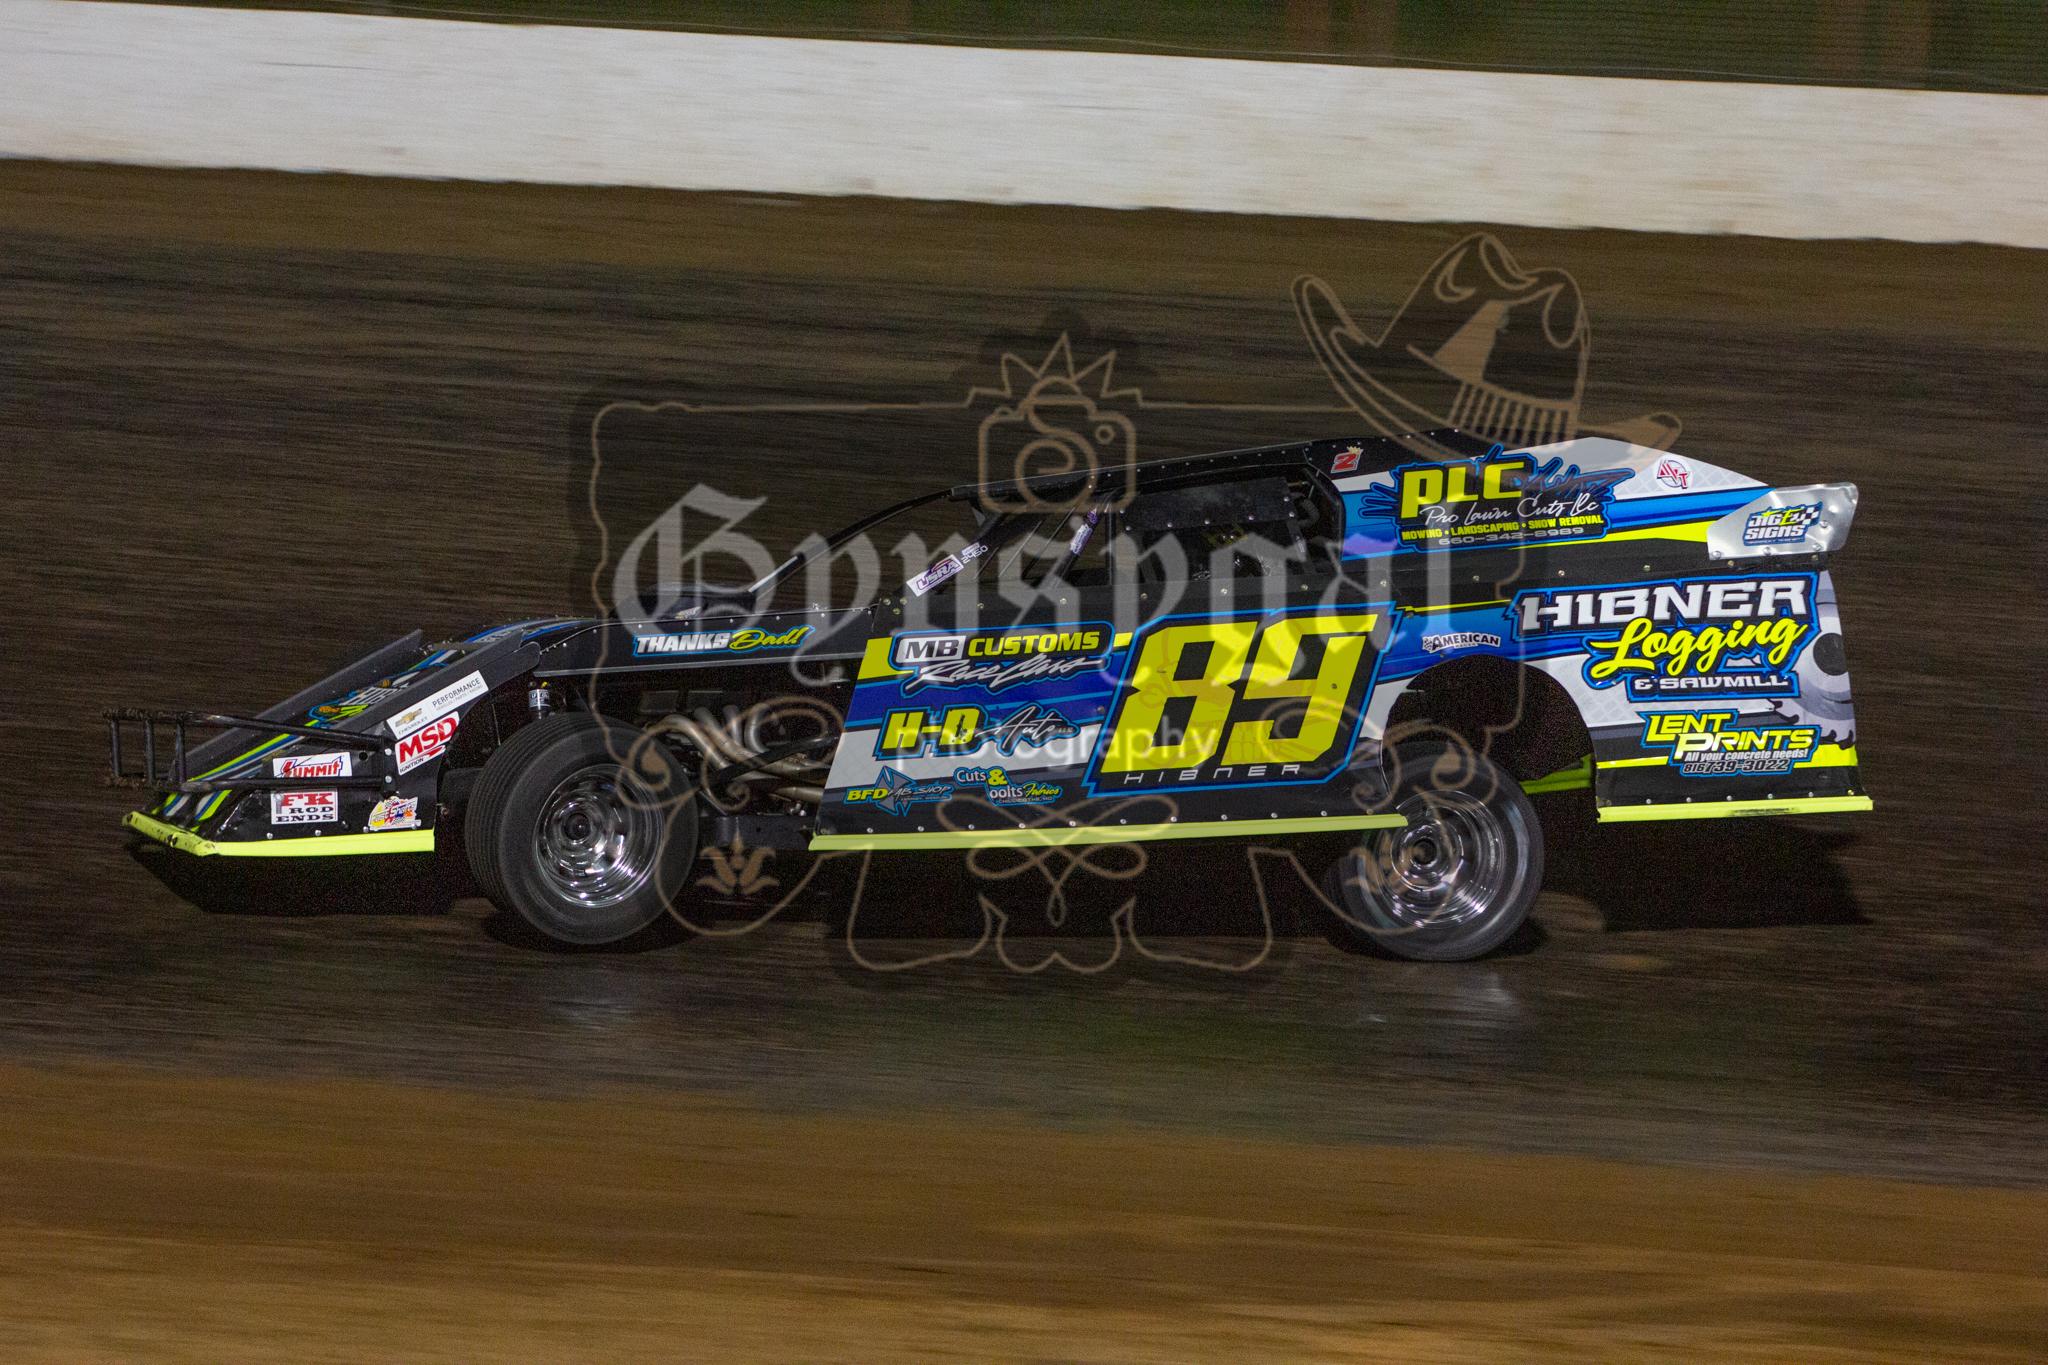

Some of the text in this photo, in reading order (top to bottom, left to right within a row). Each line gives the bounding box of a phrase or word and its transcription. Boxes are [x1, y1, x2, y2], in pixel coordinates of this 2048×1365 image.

[1401, 462, 1524, 518] PLC
[1420, 505, 1459, 526] Pro
[1464, 502, 1511, 526] Lawn
[1517, 493, 1567, 519] Cuts
[1402, 515, 1604, 541] MOWING LANDSCAPING SNOW REMOVAL
[1438, 527, 1584, 546] 660-342-8989
[1744, 525, 1805, 540] SIGNS
[916, 557, 962, 591] USRA
[1520, 580, 1807, 630] HIBNER
[637, 627, 810, 653] THANKS Dad!
[905, 631, 1100, 660] MB CUSTOMS
[1431, 633, 1499, 651] AMERICAN
[1589, 617, 1808, 679] Logging
[905, 659, 994, 691] Race
[1633, 674, 1788, 690] & SAWMILL
[432, 676, 481, 707] PERFORMANCE
[1100, 614, 1377, 772] 89
[400, 717, 457, 764] MSD
[882, 705, 1063, 750] H-D Auto
[1646, 713, 1731, 742] LENT
[1674, 729, 1815, 760] PRINTS
[1684, 748, 1808, 763] All your concrete needs!
[399, 758, 424, 773] IGNITION
[956, 768, 1008, 786] Cuts &
[1123, 764, 1301, 785] HIBNER
[281, 792, 334, 806] FK
[846, 788, 888, 801] BFD
[275, 813, 334, 823] ENDS
[288, 806, 334, 814] ROD
